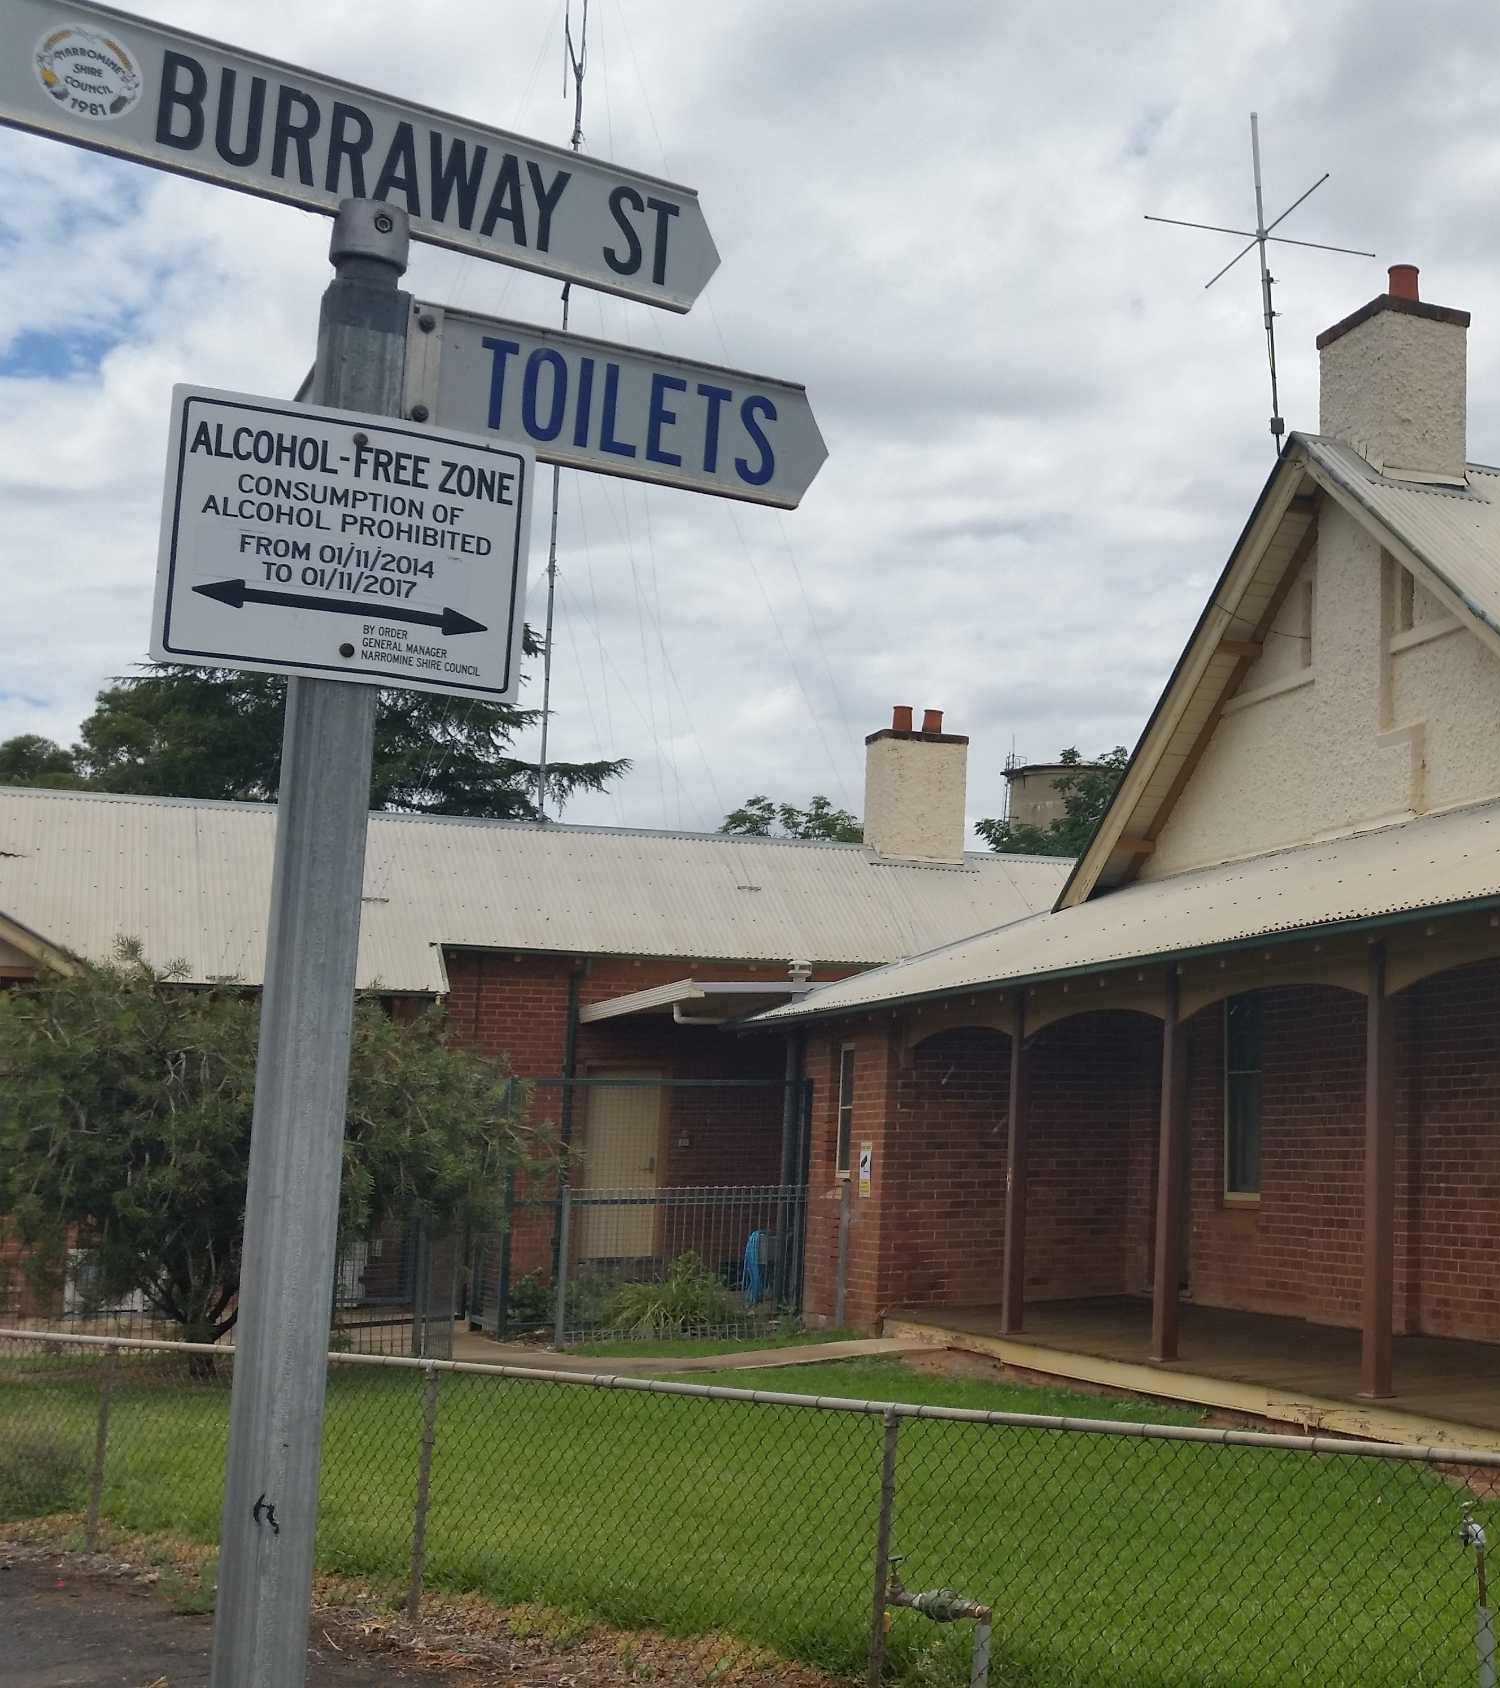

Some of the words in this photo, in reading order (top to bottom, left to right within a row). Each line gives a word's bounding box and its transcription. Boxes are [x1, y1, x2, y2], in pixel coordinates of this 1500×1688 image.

[64, 75, 113, 95] COUNCIL
[73, 63, 104, 78] SHIRE
[71, 97, 107, 116] 1981
[155, 50, 572, 253] BURRAWAY
[603, 186, 680, 286] ST
[482, 336, 778, 486] TOILETS
[190, 421, 431, 490] ALCOHOL-FREE
[438, 460, 515, 506] ZONE
[238, 473, 424, 524] CONSUMPTION
[432, 504, 465, 526] OF
[201, 494, 331, 531] ALCOHOL
[340, 513, 492, 556] PROHIBITED
[239, 534, 311, 561] FROM
[319, 542, 435, 579] 01/11/2014
[262, 560, 293, 583] TO
[300, 565, 417, 599] 01/11/2017
[362, 638, 402, 652] GENERAL
[406, 643, 447, 659] MANAGER
[363, 624, 375, 635] BY
[378, 626, 408, 640] ORDER
[361, 650, 413, 666] NARROMINE
[416, 658, 441, 670] SHIRE
[444, 662, 480, 676] COUNCIL
